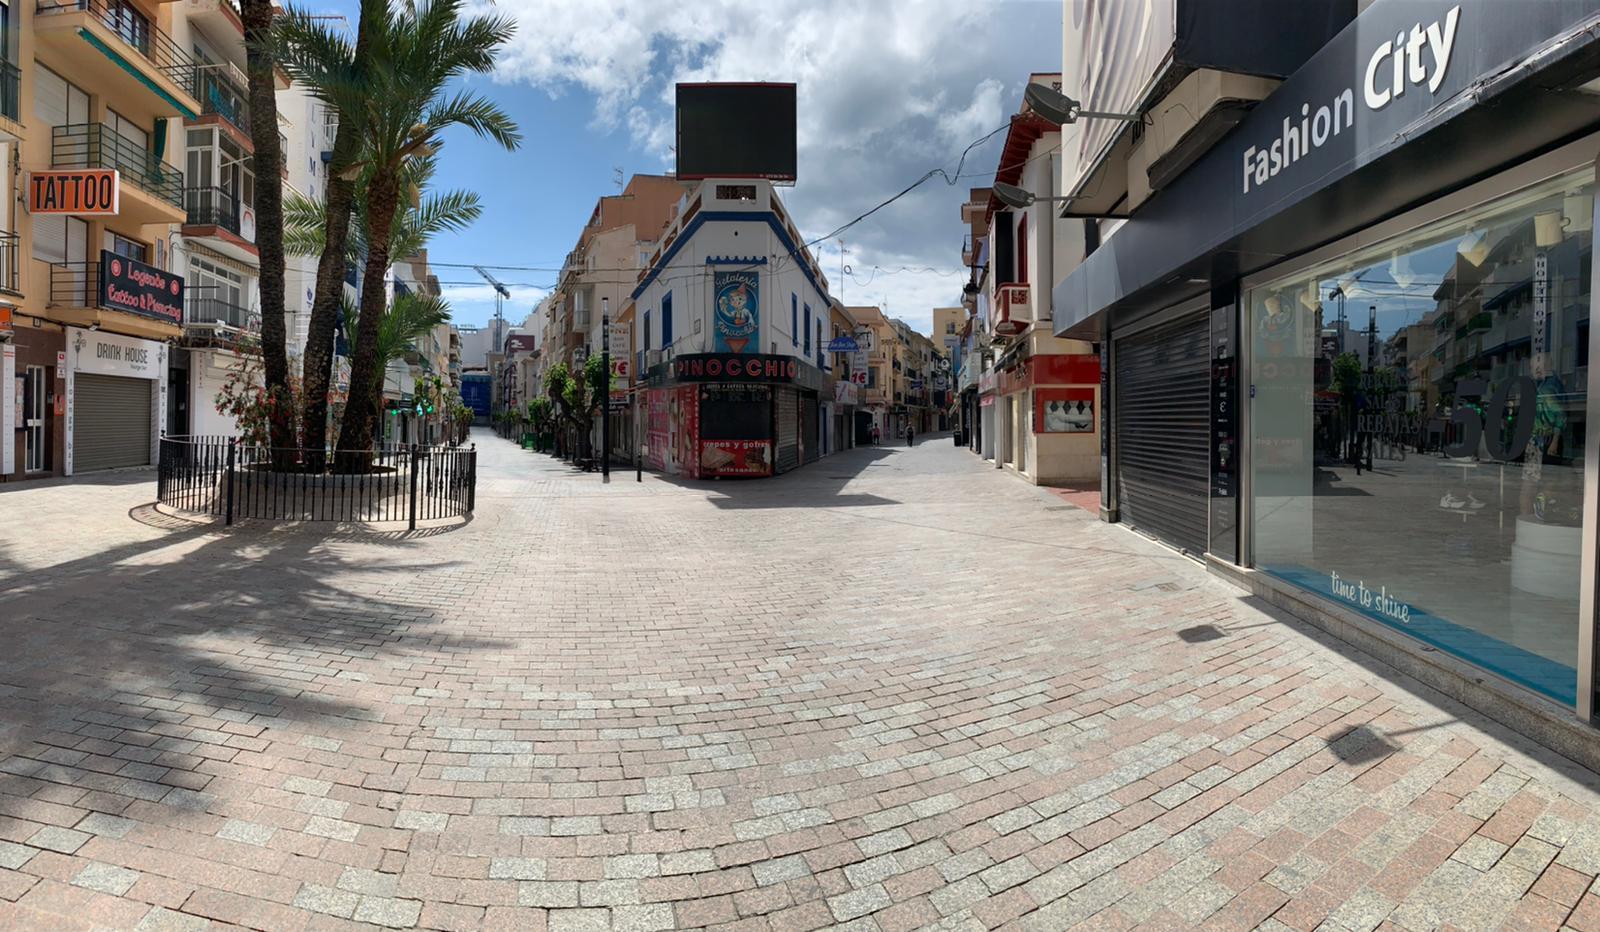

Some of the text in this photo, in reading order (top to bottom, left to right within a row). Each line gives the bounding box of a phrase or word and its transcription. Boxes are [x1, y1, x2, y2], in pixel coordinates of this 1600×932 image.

[1242, 5, 1460, 194] Fashion City
[32, 174, 112, 210] TATTOO
[97, 342, 148, 364] DRINK HOUSE
[677, 359, 797, 378] PINOCCHIO
[851, 371, 867, 383] 1€
[1357, 414, 1423, 438] REBAJAS
[1446, 376, 1537, 461] 50
[703, 441, 731, 449] crepes
[734, 442, 740, 450] y
[1330, 570, 1410, 623] time to shine
